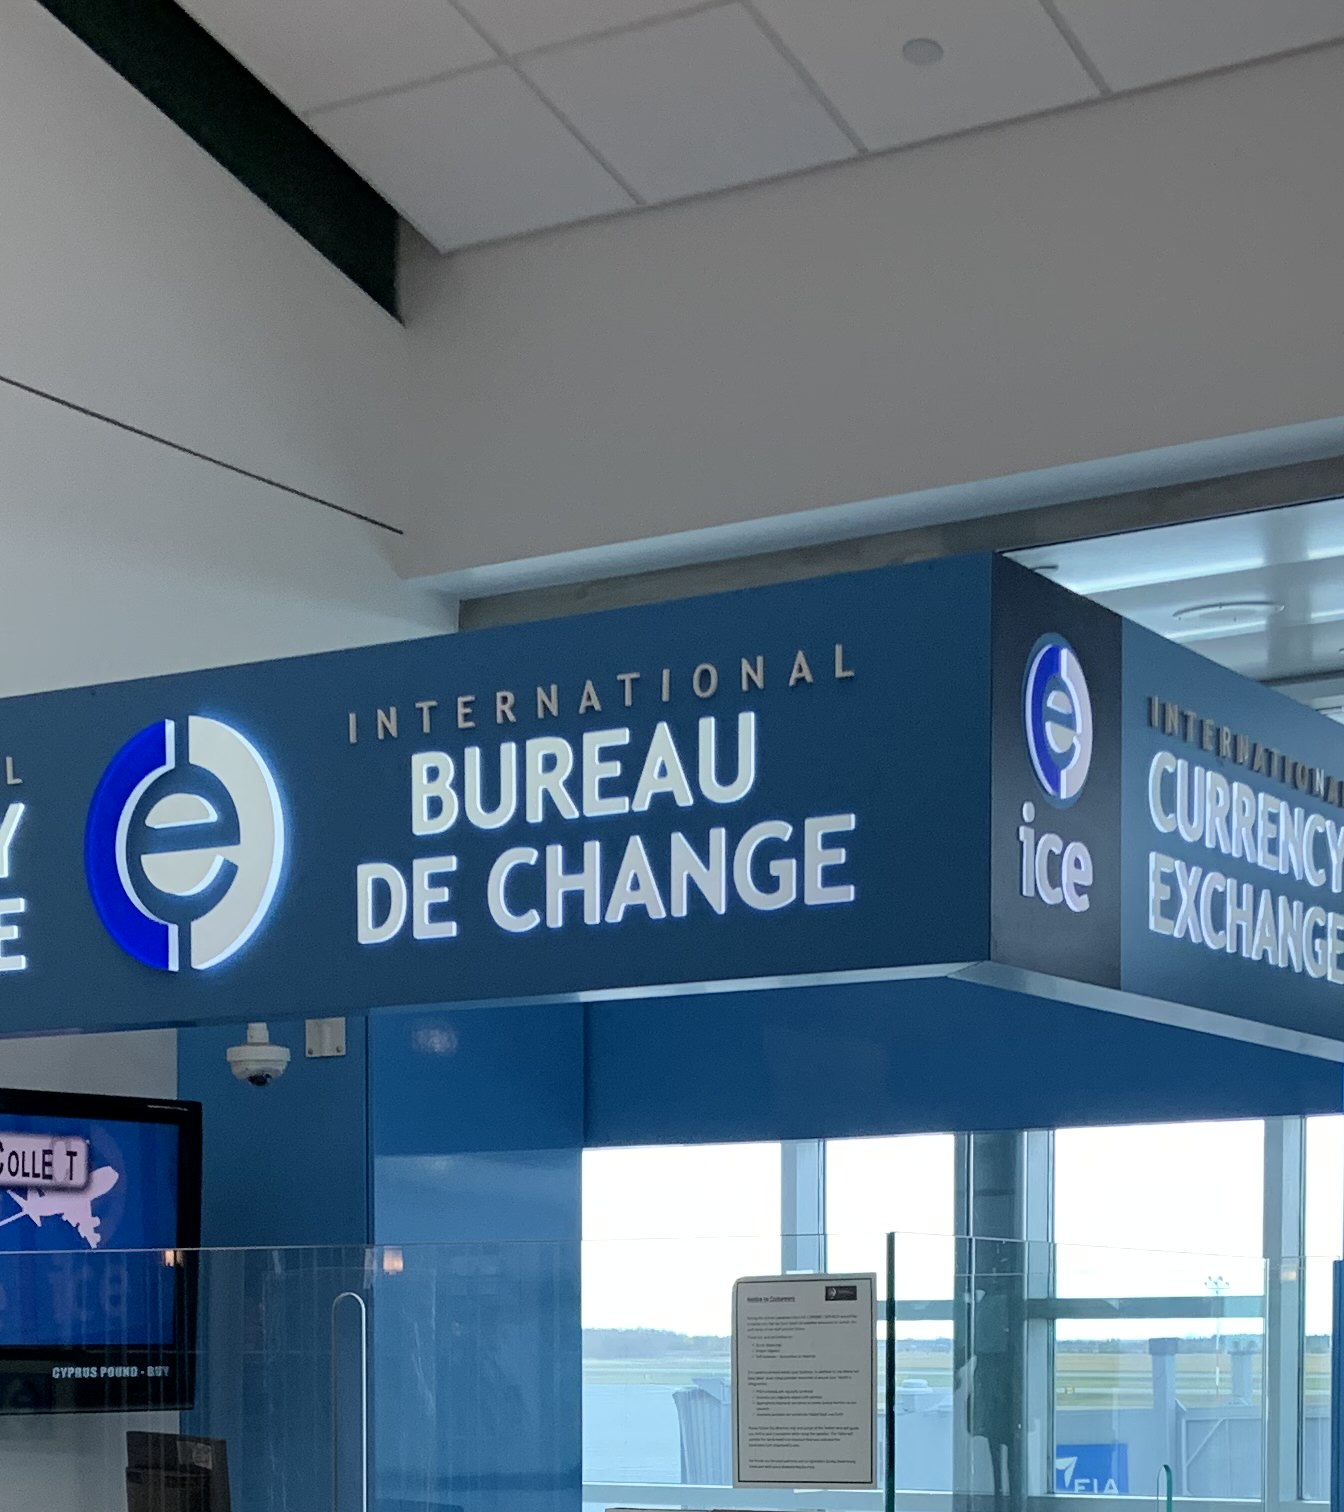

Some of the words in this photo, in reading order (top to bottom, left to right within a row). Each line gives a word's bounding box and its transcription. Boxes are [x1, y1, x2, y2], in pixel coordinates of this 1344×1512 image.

[347, 643, 855, 744] INTERNATIONAL
[411, 711, 756, 836] BUREAU
[357, 854, 458, 944] DE
[487, 813, 856, 933] CHANGE
[1017, 802, 1093, 912] ice
[52, 1366, 97, 1379] CYPRUS
[100, 1366, 138, 1378] POUND
[147, 1366, 170, 1377] BUY
